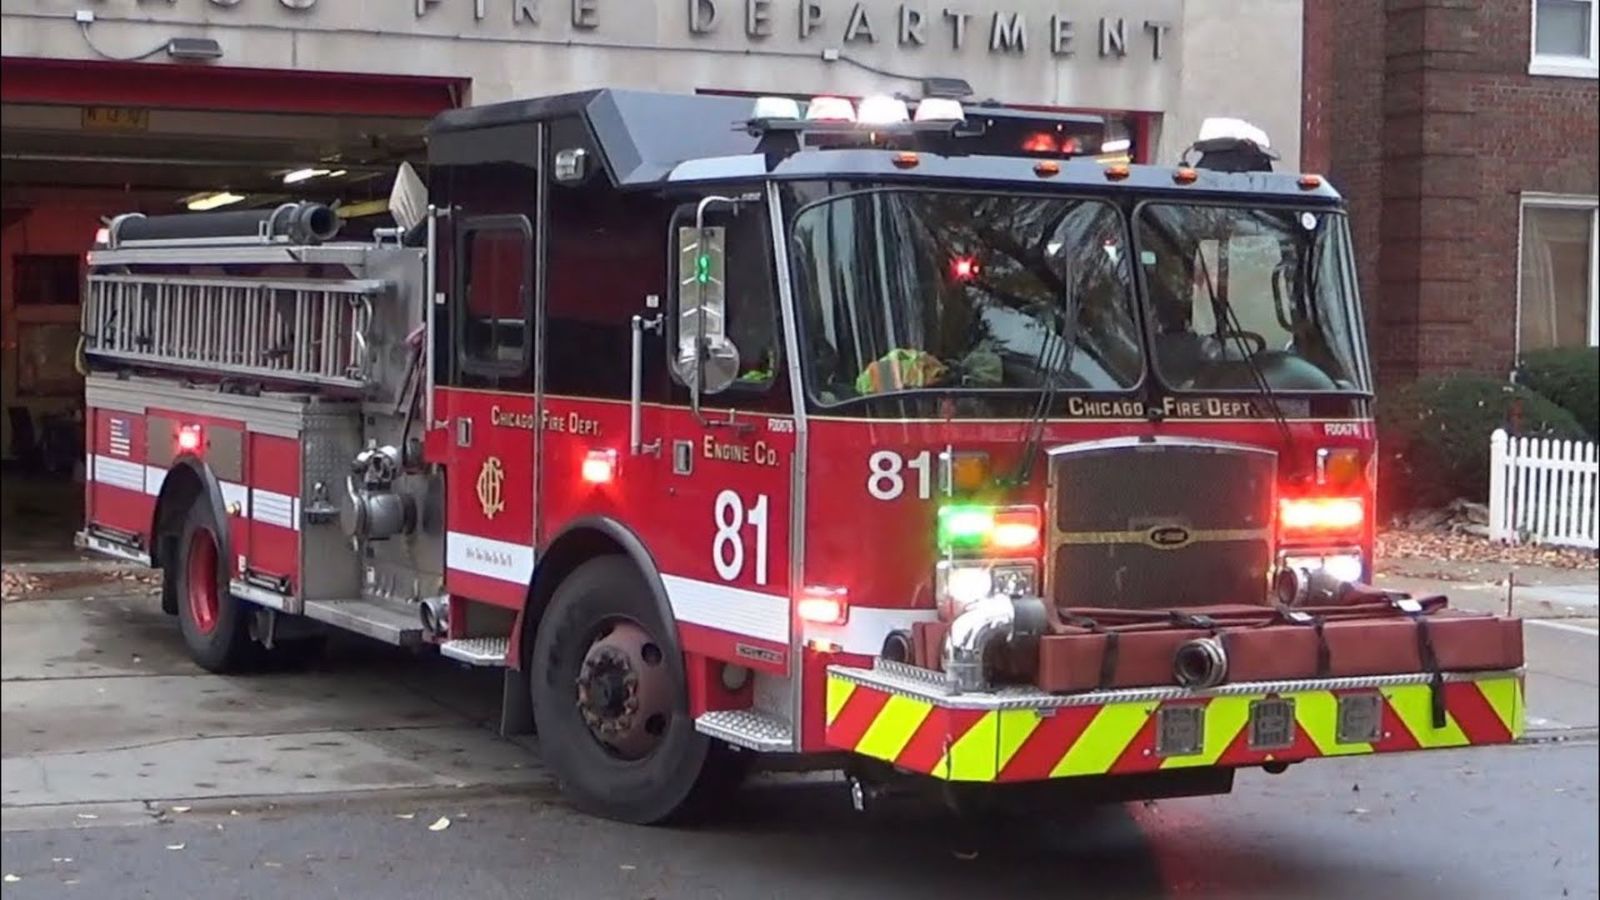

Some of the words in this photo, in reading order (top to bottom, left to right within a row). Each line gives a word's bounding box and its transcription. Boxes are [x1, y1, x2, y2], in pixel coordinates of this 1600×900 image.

[689, 0, 1173, 60] DEPARTMENT
[541, 409, 566, 433] FIRE
[1068, 397, 1144, 417] CHICAGO
[1162, 397, 1203, 417] FIRE
[703, 435, 750, 463] ENGINE
[867, 450, 931, 500] 81
[712, 489, 768, 586] 81
